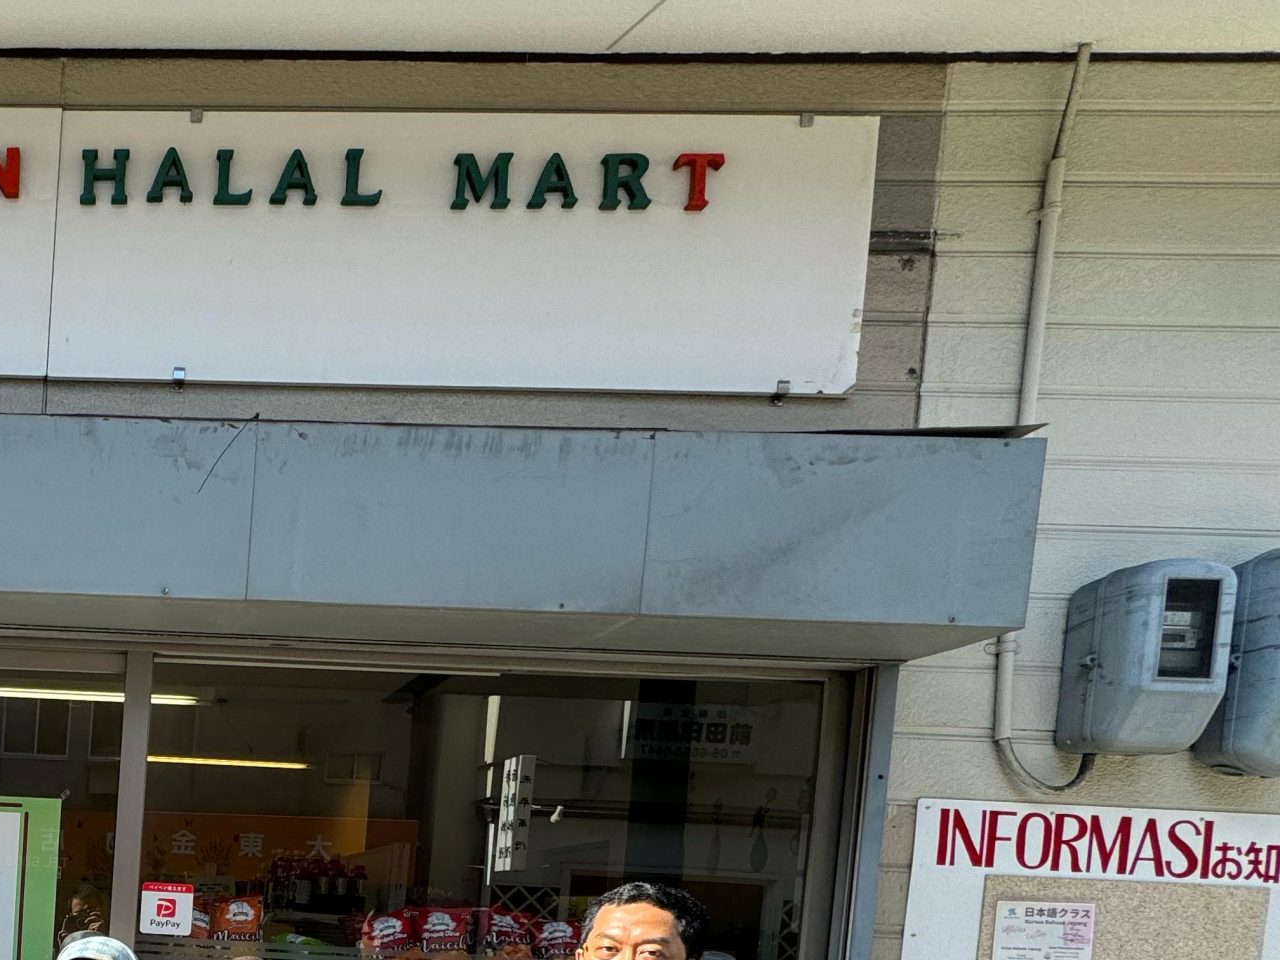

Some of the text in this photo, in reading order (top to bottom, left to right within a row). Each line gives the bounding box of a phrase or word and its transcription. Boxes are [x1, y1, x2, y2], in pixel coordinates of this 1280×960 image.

[80, 146, 383, 208] HALAL
[451, 151, 726, 214] MART
[935, 807, 1215, 880] INFORMASI
[150, 918, 181, 929] PayPay
[1024, 907, 1091, 919] 日本語クラス
